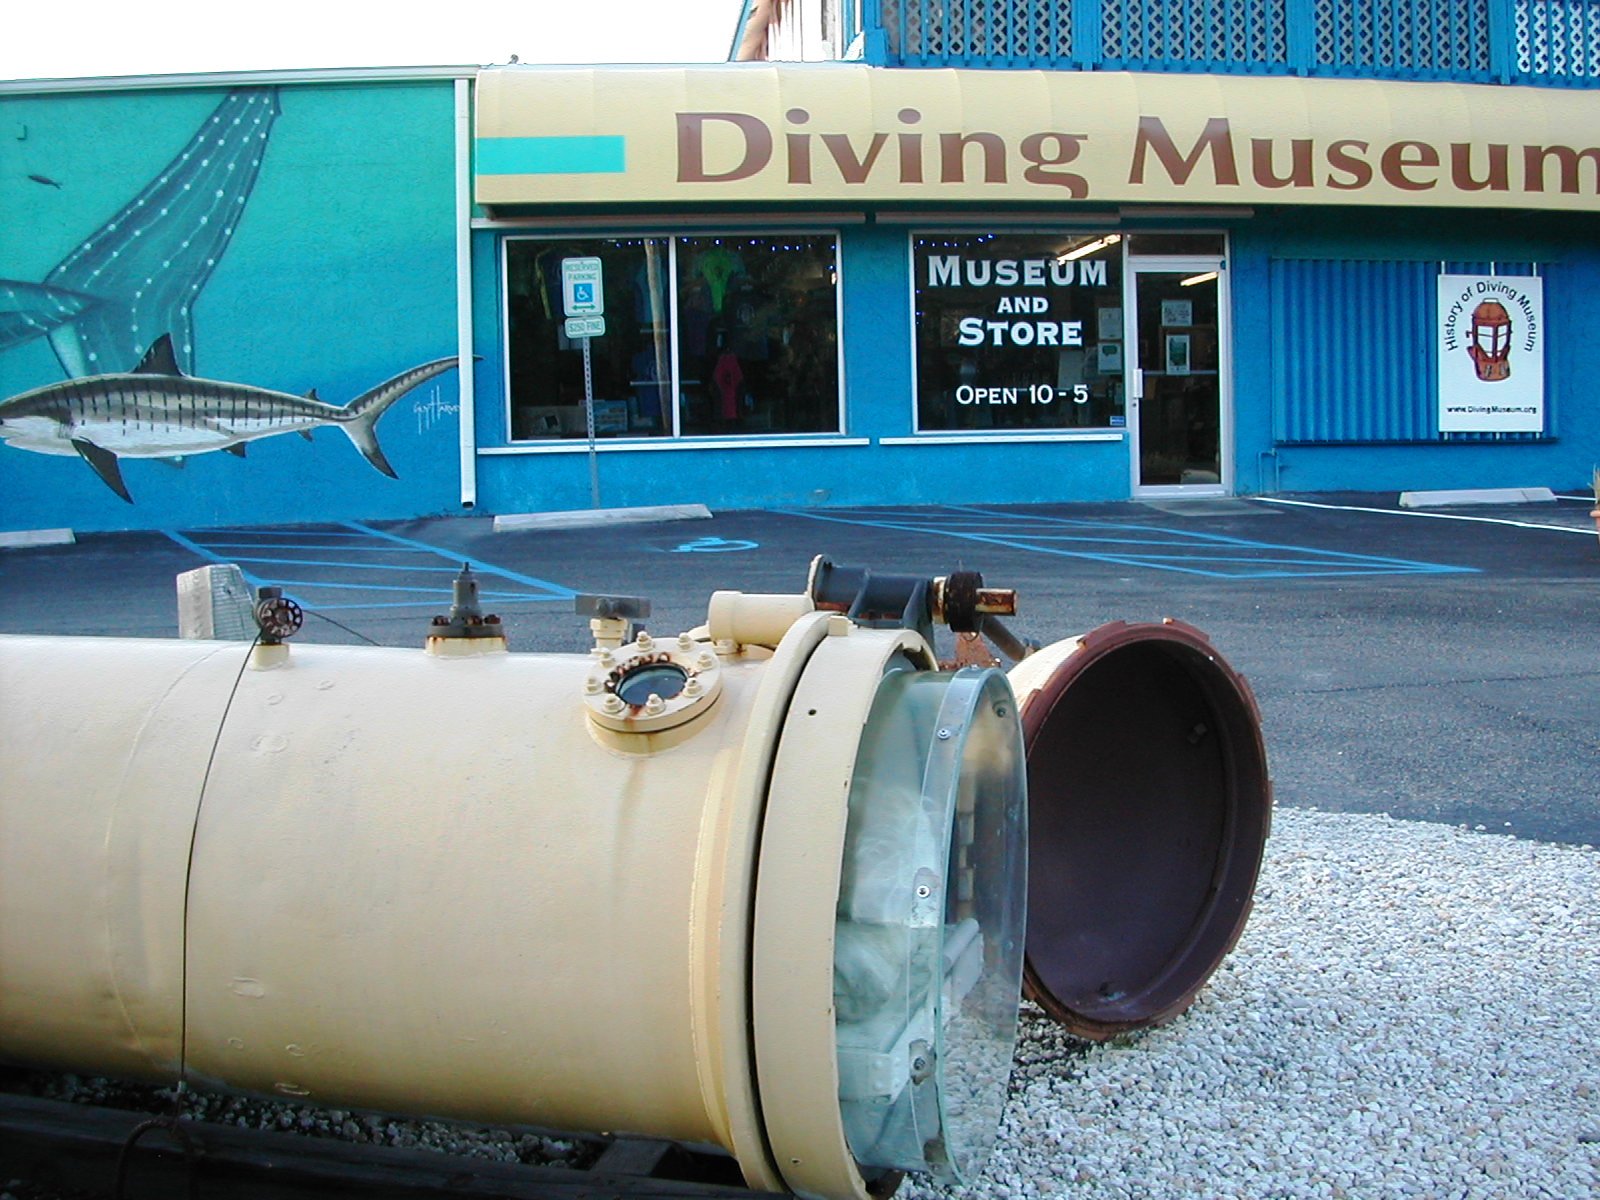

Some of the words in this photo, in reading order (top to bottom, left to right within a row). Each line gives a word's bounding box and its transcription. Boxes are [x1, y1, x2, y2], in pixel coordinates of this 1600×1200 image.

[675, 108, 1089, 200] Diving
[1128, 115, 1600, 195] Museum
[928, 255, 1107, 287] MUSEUM
[997, 297, 1049, 314] AND
[1444, 301, 1463, 351] History
[1461, 286, 1473, 302] of
[1476, 281, 1517, 300] Diving
[1516, 295, 1536, 352] Museum
[568, 323, 585, 333] $250
[586, 321, 601, 331] FINE
[958, 317, 1083, 347] STORE
[956, 384, 1018, 405] OPEN
[1030, 384, 1053, 404] 10
[1073, 384, 1089, 404] 5
